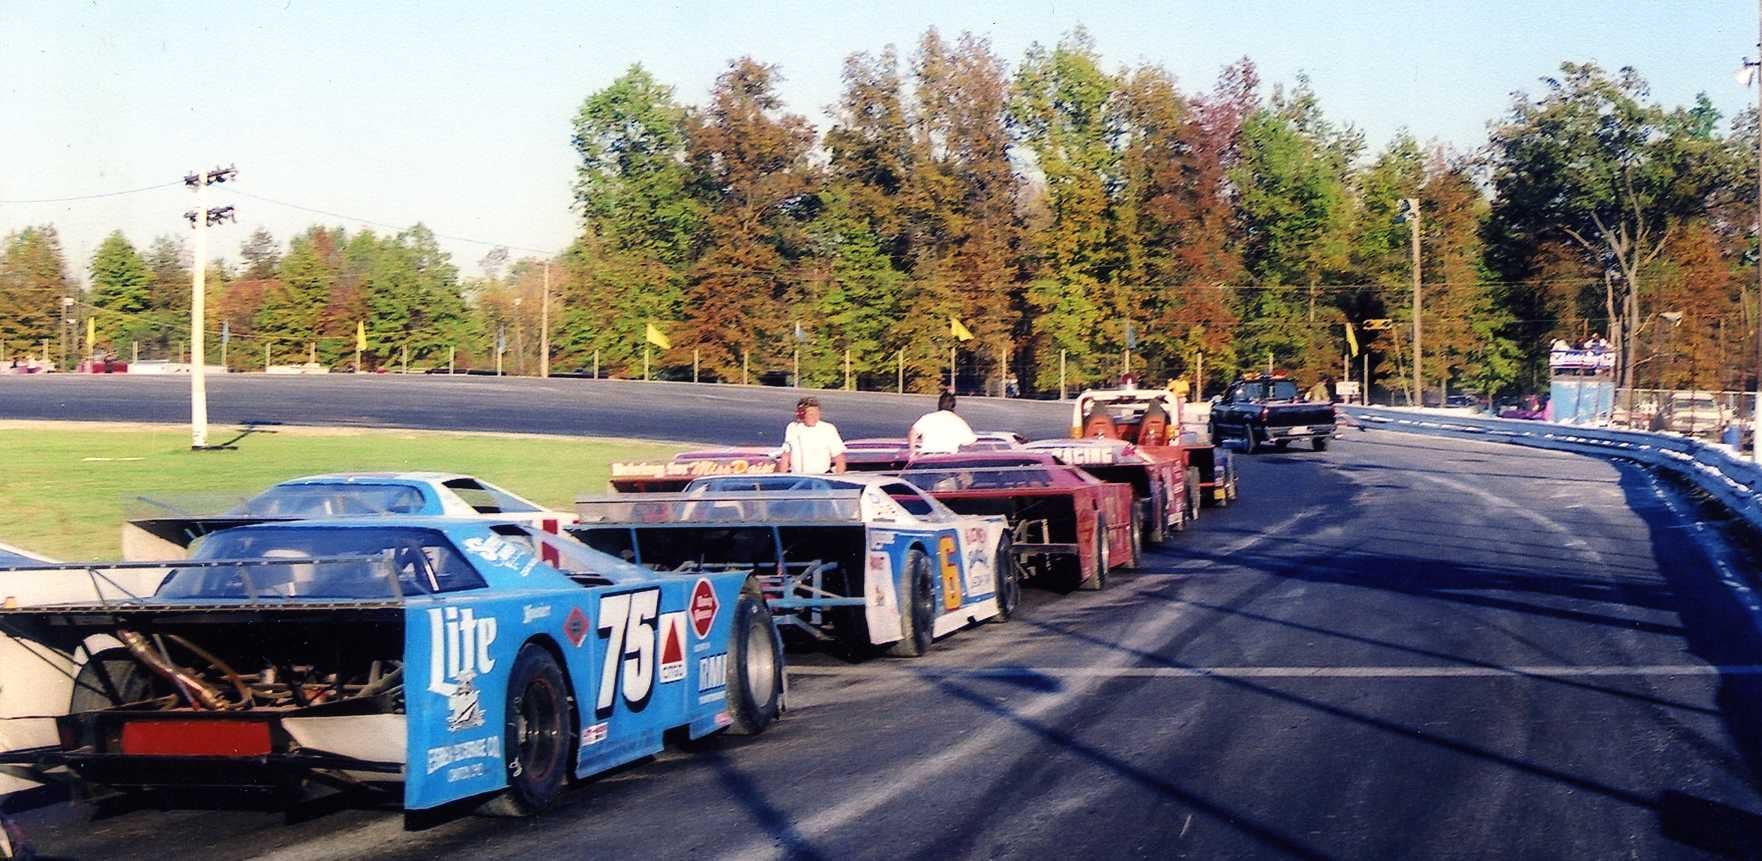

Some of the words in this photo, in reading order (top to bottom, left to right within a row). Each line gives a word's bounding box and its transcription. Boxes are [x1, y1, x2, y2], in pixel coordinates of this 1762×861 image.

[938, 536, 963, 612] 6
[427, 606, 497, 697] Lite
[596, 586, 661, 719] 75
